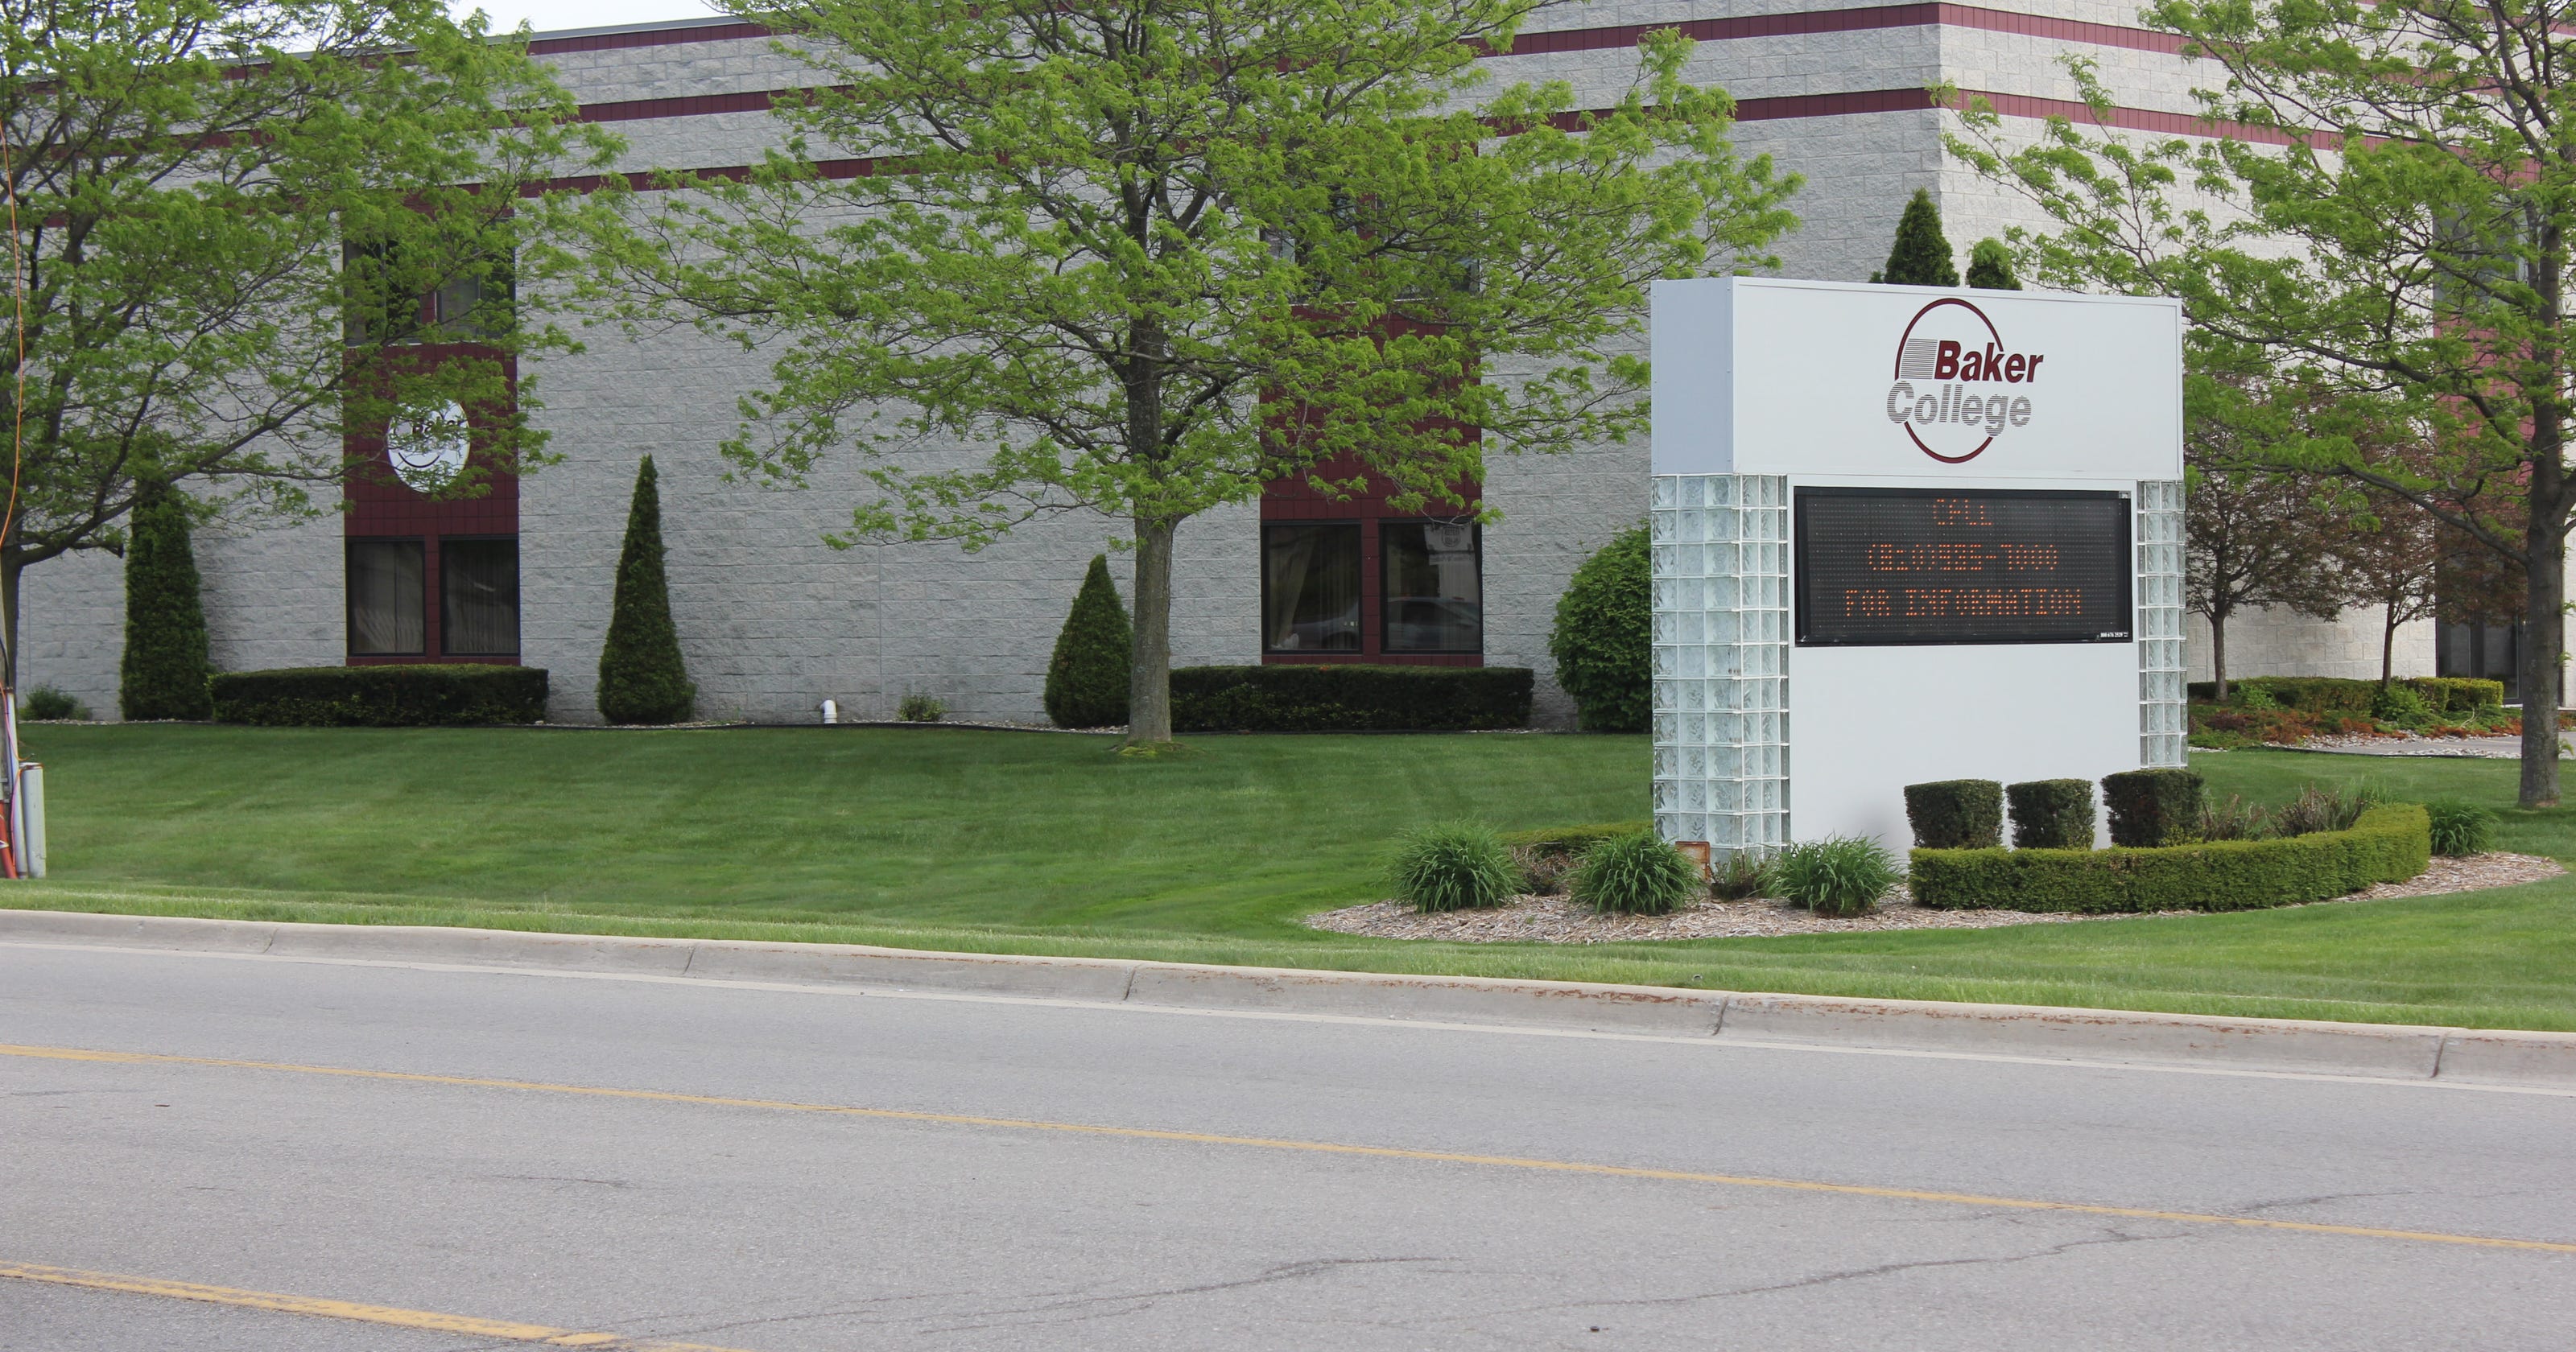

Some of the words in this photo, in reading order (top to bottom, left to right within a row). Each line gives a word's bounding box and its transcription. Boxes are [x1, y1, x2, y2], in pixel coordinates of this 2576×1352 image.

[1934, 340, 2044, 383] Baker
[1887, 380, 2032, 436] College
[1932, 498, 1993, 526] CALL
[1844, 588, 1890, 616] FOR
[1905, 587, 2082, 616] INFORMATION
